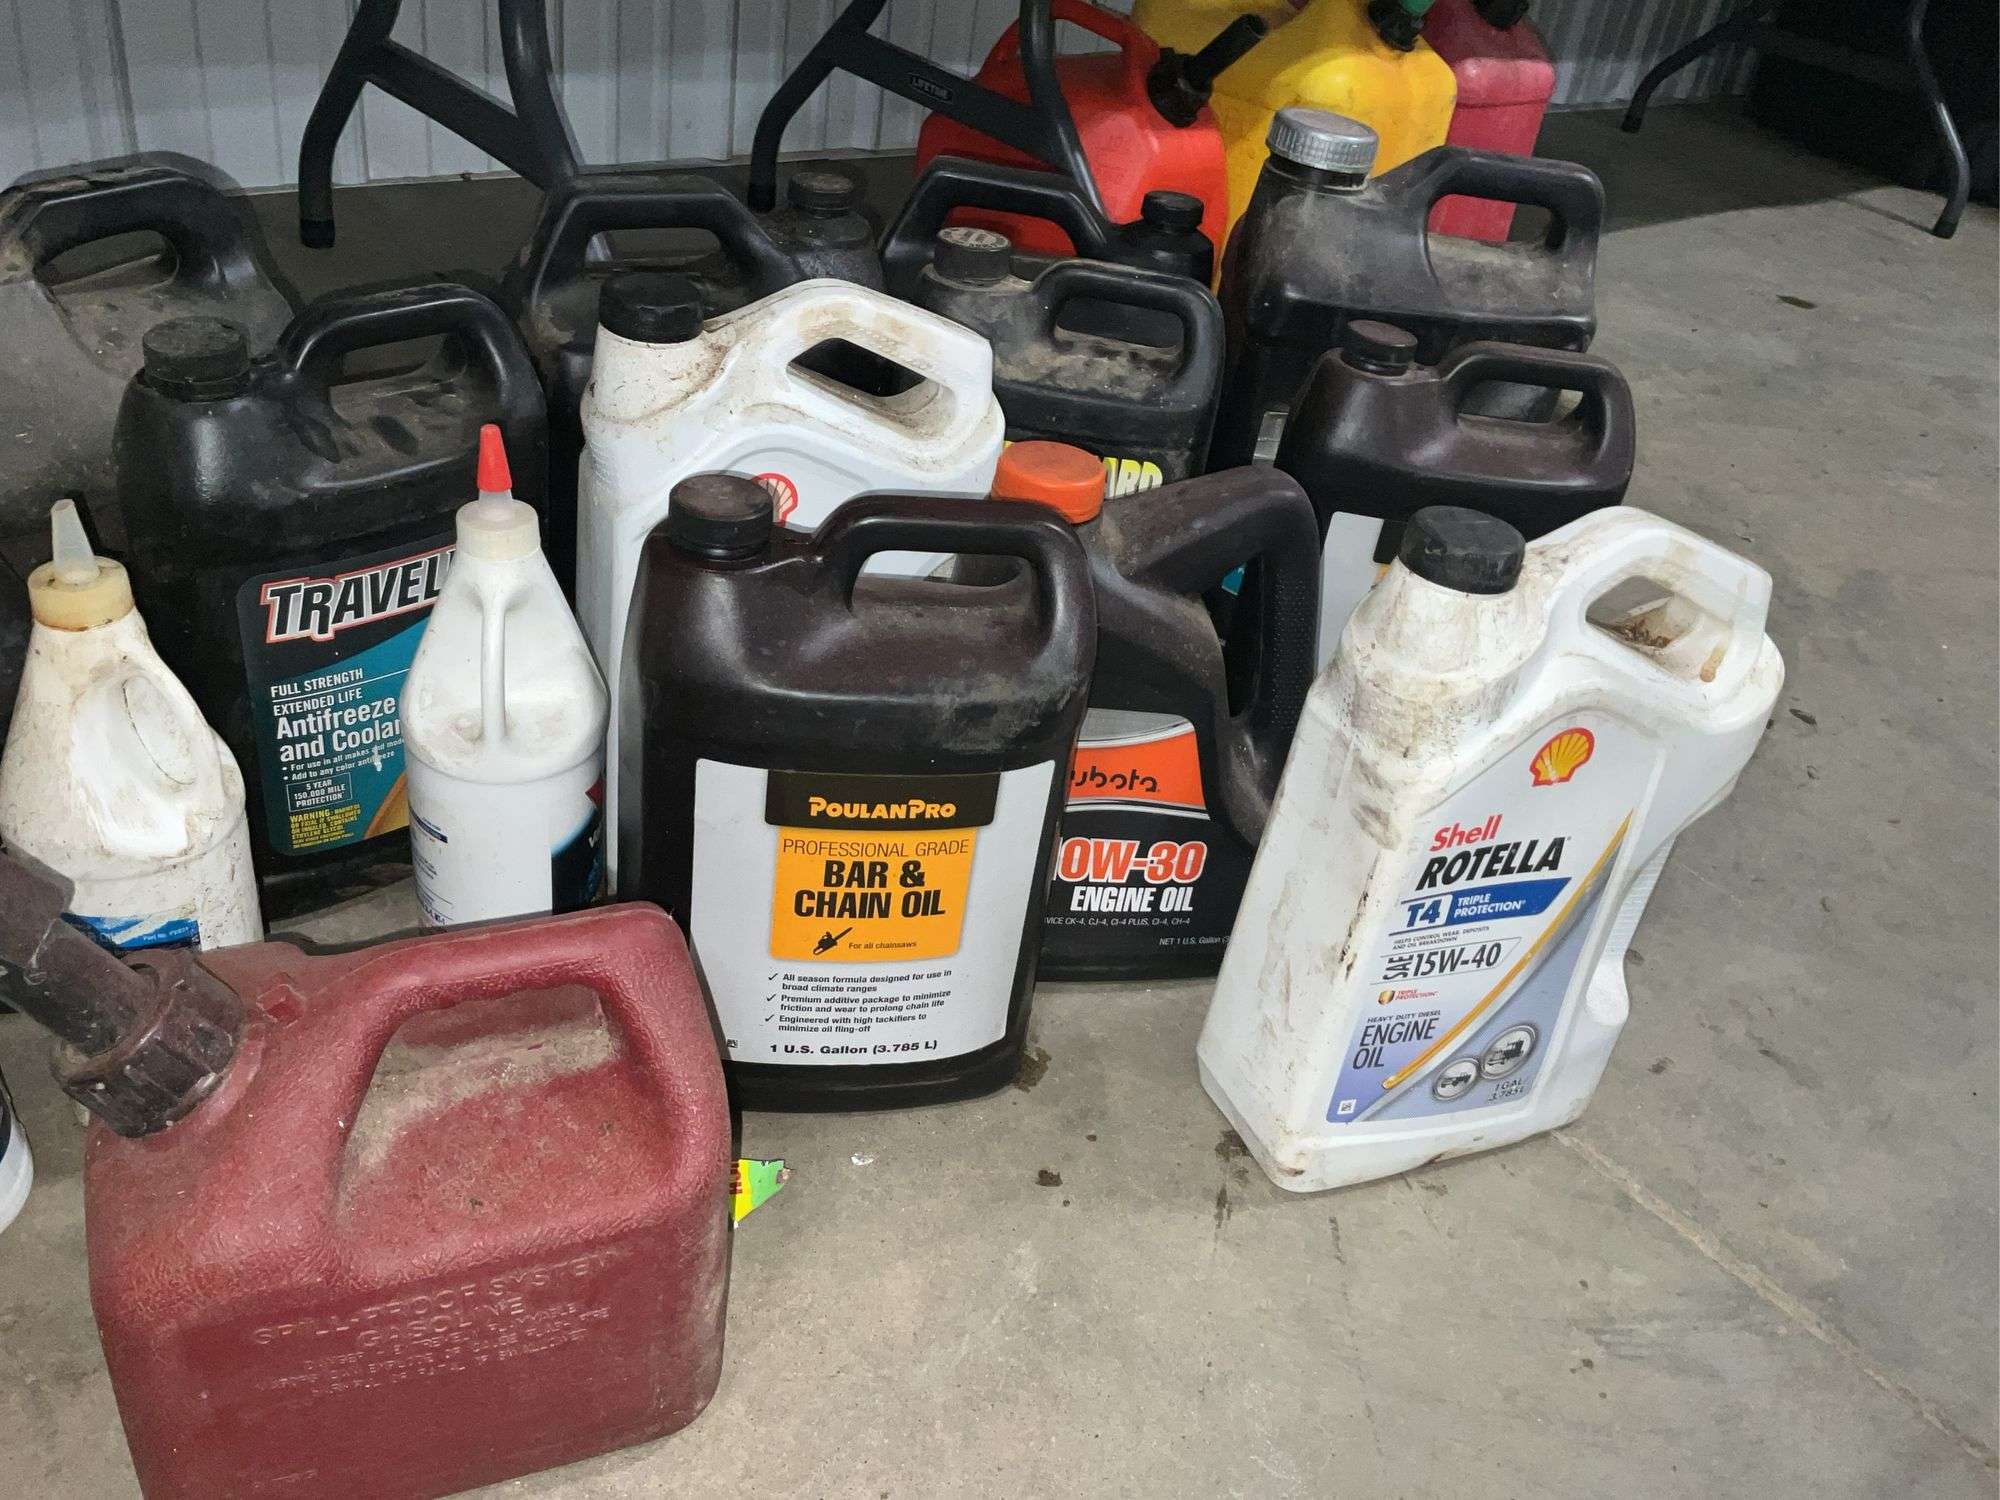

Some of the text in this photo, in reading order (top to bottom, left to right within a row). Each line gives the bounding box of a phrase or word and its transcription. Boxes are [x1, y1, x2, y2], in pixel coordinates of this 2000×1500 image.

[264, 548, 455, 640] TRAVEL
[270, 668, 363, 698] FULL STRENGTH
[273, 688, 363, 716] EXTENDED LIFE
[277, 697, 396, 739] Antifreeze
[280, 734, 325, 762] and
[290, 762, 305, 771] For
[307, 760, 321, 768] use
[291, 772, 307, 781] Add
[309, 770, 317, 778] to
[313, 779, 332, 790] YEAR
[327, 783, 346, 794] MILE
[1070, 765, 1158, 792] ubota
[1429, 814, 1503, 852] Shell
[782, 838, 969, 857] PROFESSIONAL GRADE
[1054, 835, 1208, 884] 0W-30
[823, 859, 925, 888] BAR &
[1415, 836, 1567, 891] ROTELLA
[794, 889, 946, 919] CHAIN OIL
[1070, 885, 1194, 913] ENGINE OIL
[1454, 901, 1522, 919] PROTECTION
[1457, 893, 1491, 907] TRIPLE
[1406, 899, 1443, 928] T4
[849, 939, 917, 949] For all chainsaws
[1382, 942, 1502, 980] SAE 15W-40
[781, 983, 878, 993] broad climate ranges
[782, 973, 795, 981] All
[832, 975, 867, 983] formula
[870, 974, 910, 984] designed
[912, 973, 924, 981] for
[926, 971, 942, 979] use
[780, 1003, 813, 1012] friction
[815, 1005, 832, 1013] and
[859, 1005, 868, 1013] to
[870, 1004, 903, 1014] prolong
[905, 1001, 929, 1010] chain
[931, 999, 945, 1008] life
[781, 994, 822, 1003] Premium
[824, 996, 860, 1004] additive
[862, 996, 899, 1005] package
[912, 990, 951, 1000] minimize
[778, 1024, 871, 1034] minimize oil fling-off
[779, 1015, 829, 1025] Engineered
[832, 1016, 851, 1024] with
[853, 1016, 873, 1025] high
[875, 1014, 916, 1023] tackifiers
[1359, 1017, 1440, 1047] ENGINE
[769, 1039, 938, 1057] 1 U.S. Gallon (3.785 L)
[1352, 1046, 1385, 1070] OIL
